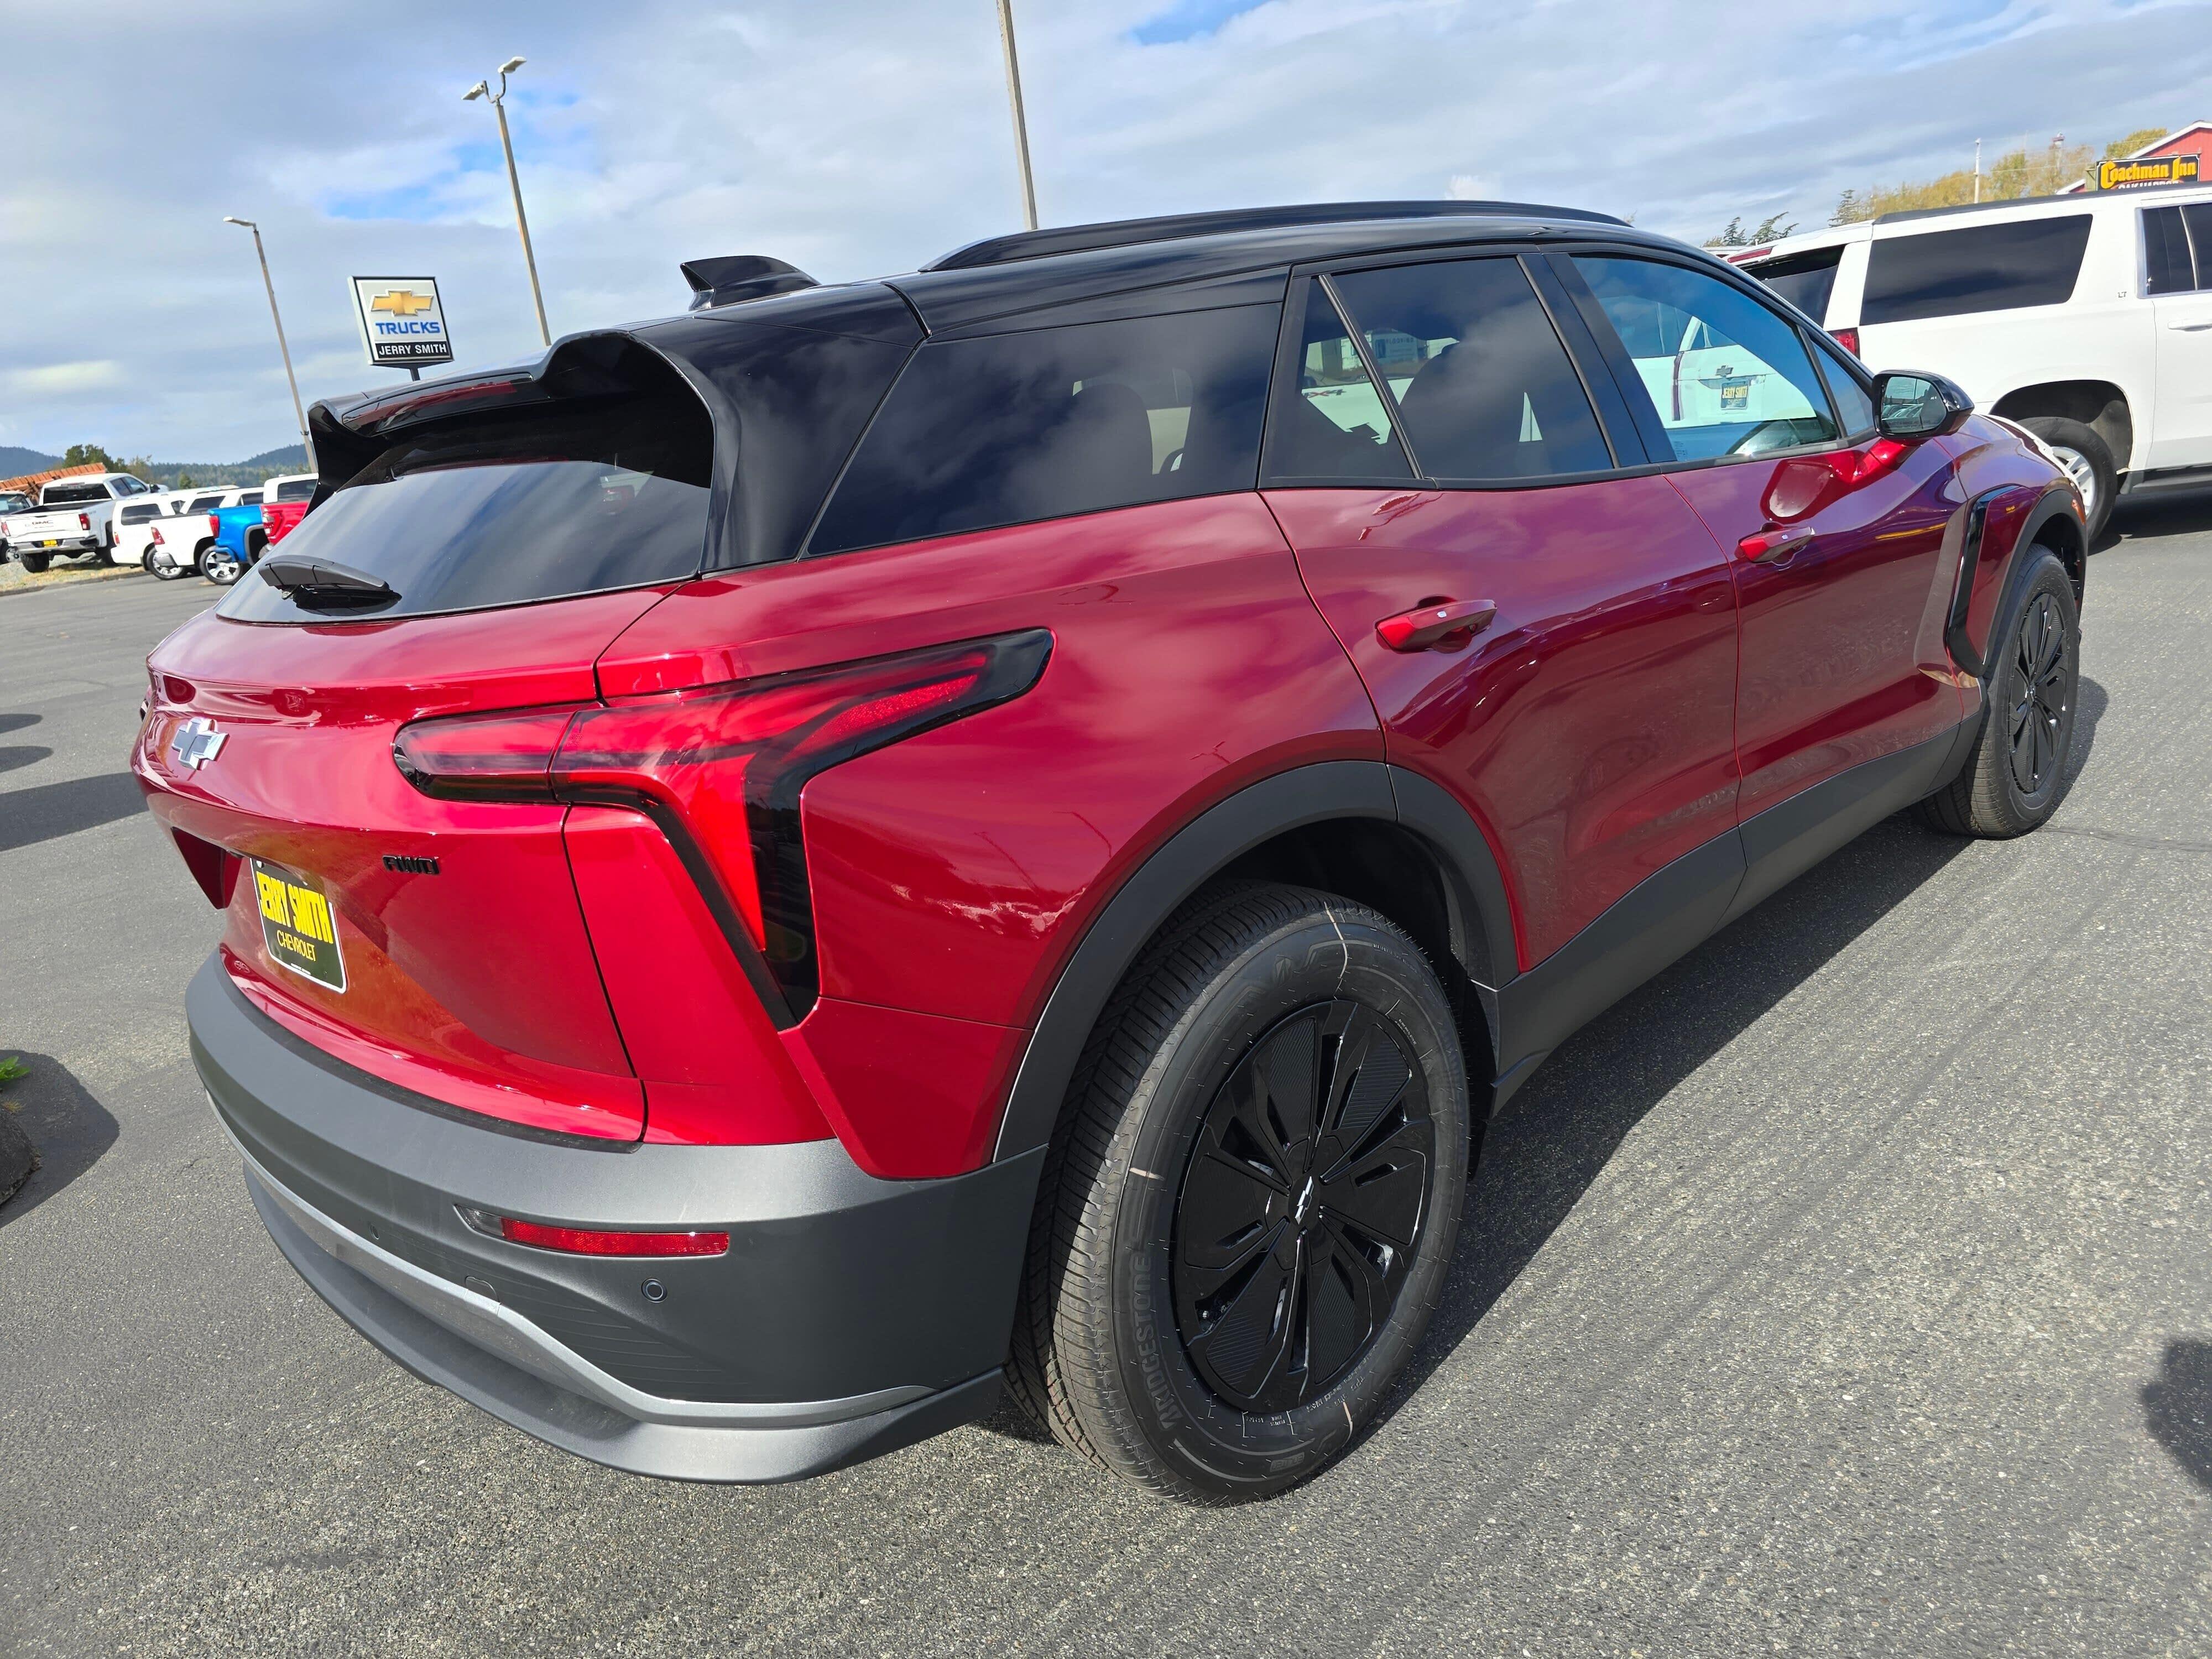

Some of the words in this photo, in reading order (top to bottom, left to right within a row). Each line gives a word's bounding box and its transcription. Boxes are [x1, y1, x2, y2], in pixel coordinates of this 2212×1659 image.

[2100, 160, 2169, 189] Coachman
[2172, 156, 2197, 181] Inn
[375, 322, 441, 335] TRUCKS
[379, 345, 411, 356] JERRY
[415, 343, 447, 354] SMITH
[383, 855, 440, 875] AWD
[256, 871, 291, 928] JERRY
[288, 883, 333, 944] SMITH
[277, 930, 316, 962] CHEVROLET
[1133, 1255, 1184, 1430] BRIDGESTONE
